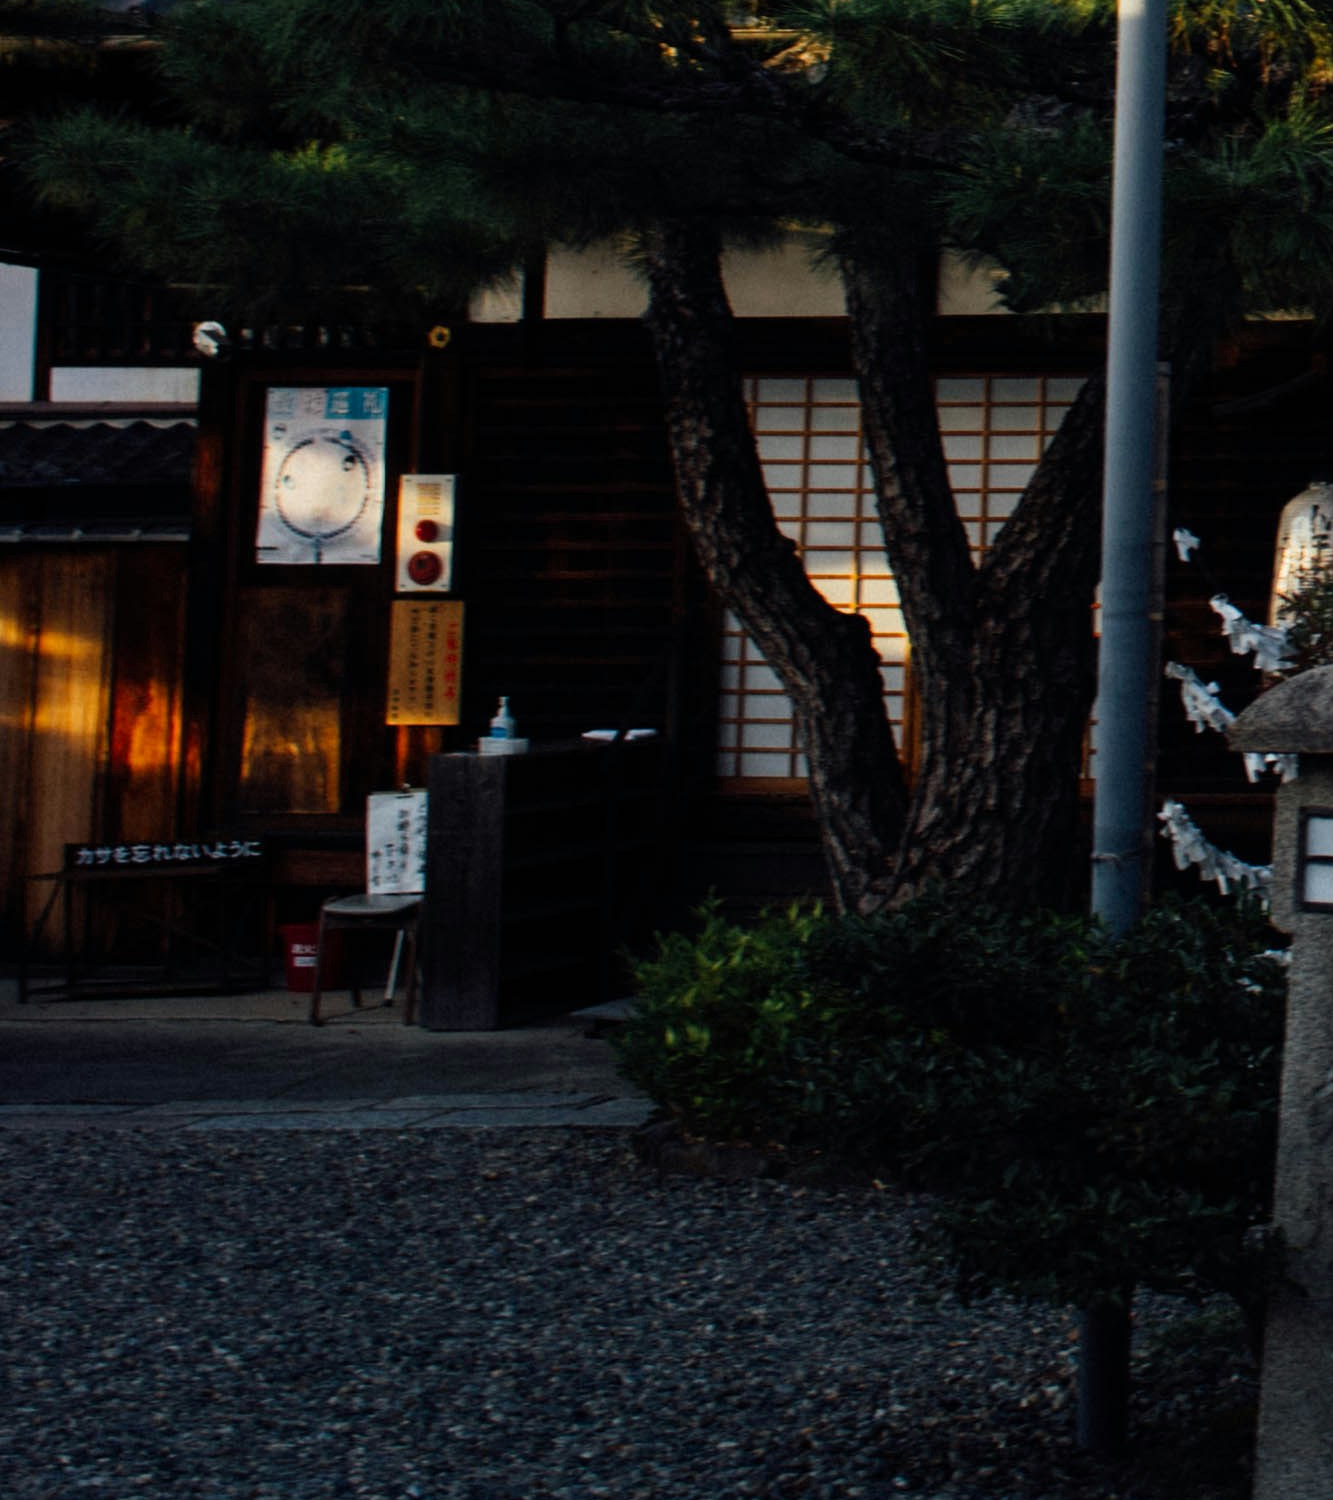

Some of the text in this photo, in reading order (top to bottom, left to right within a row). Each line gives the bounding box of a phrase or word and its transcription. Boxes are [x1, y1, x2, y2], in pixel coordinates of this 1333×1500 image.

[75, 839, 264, 865] カサを忘れないように
